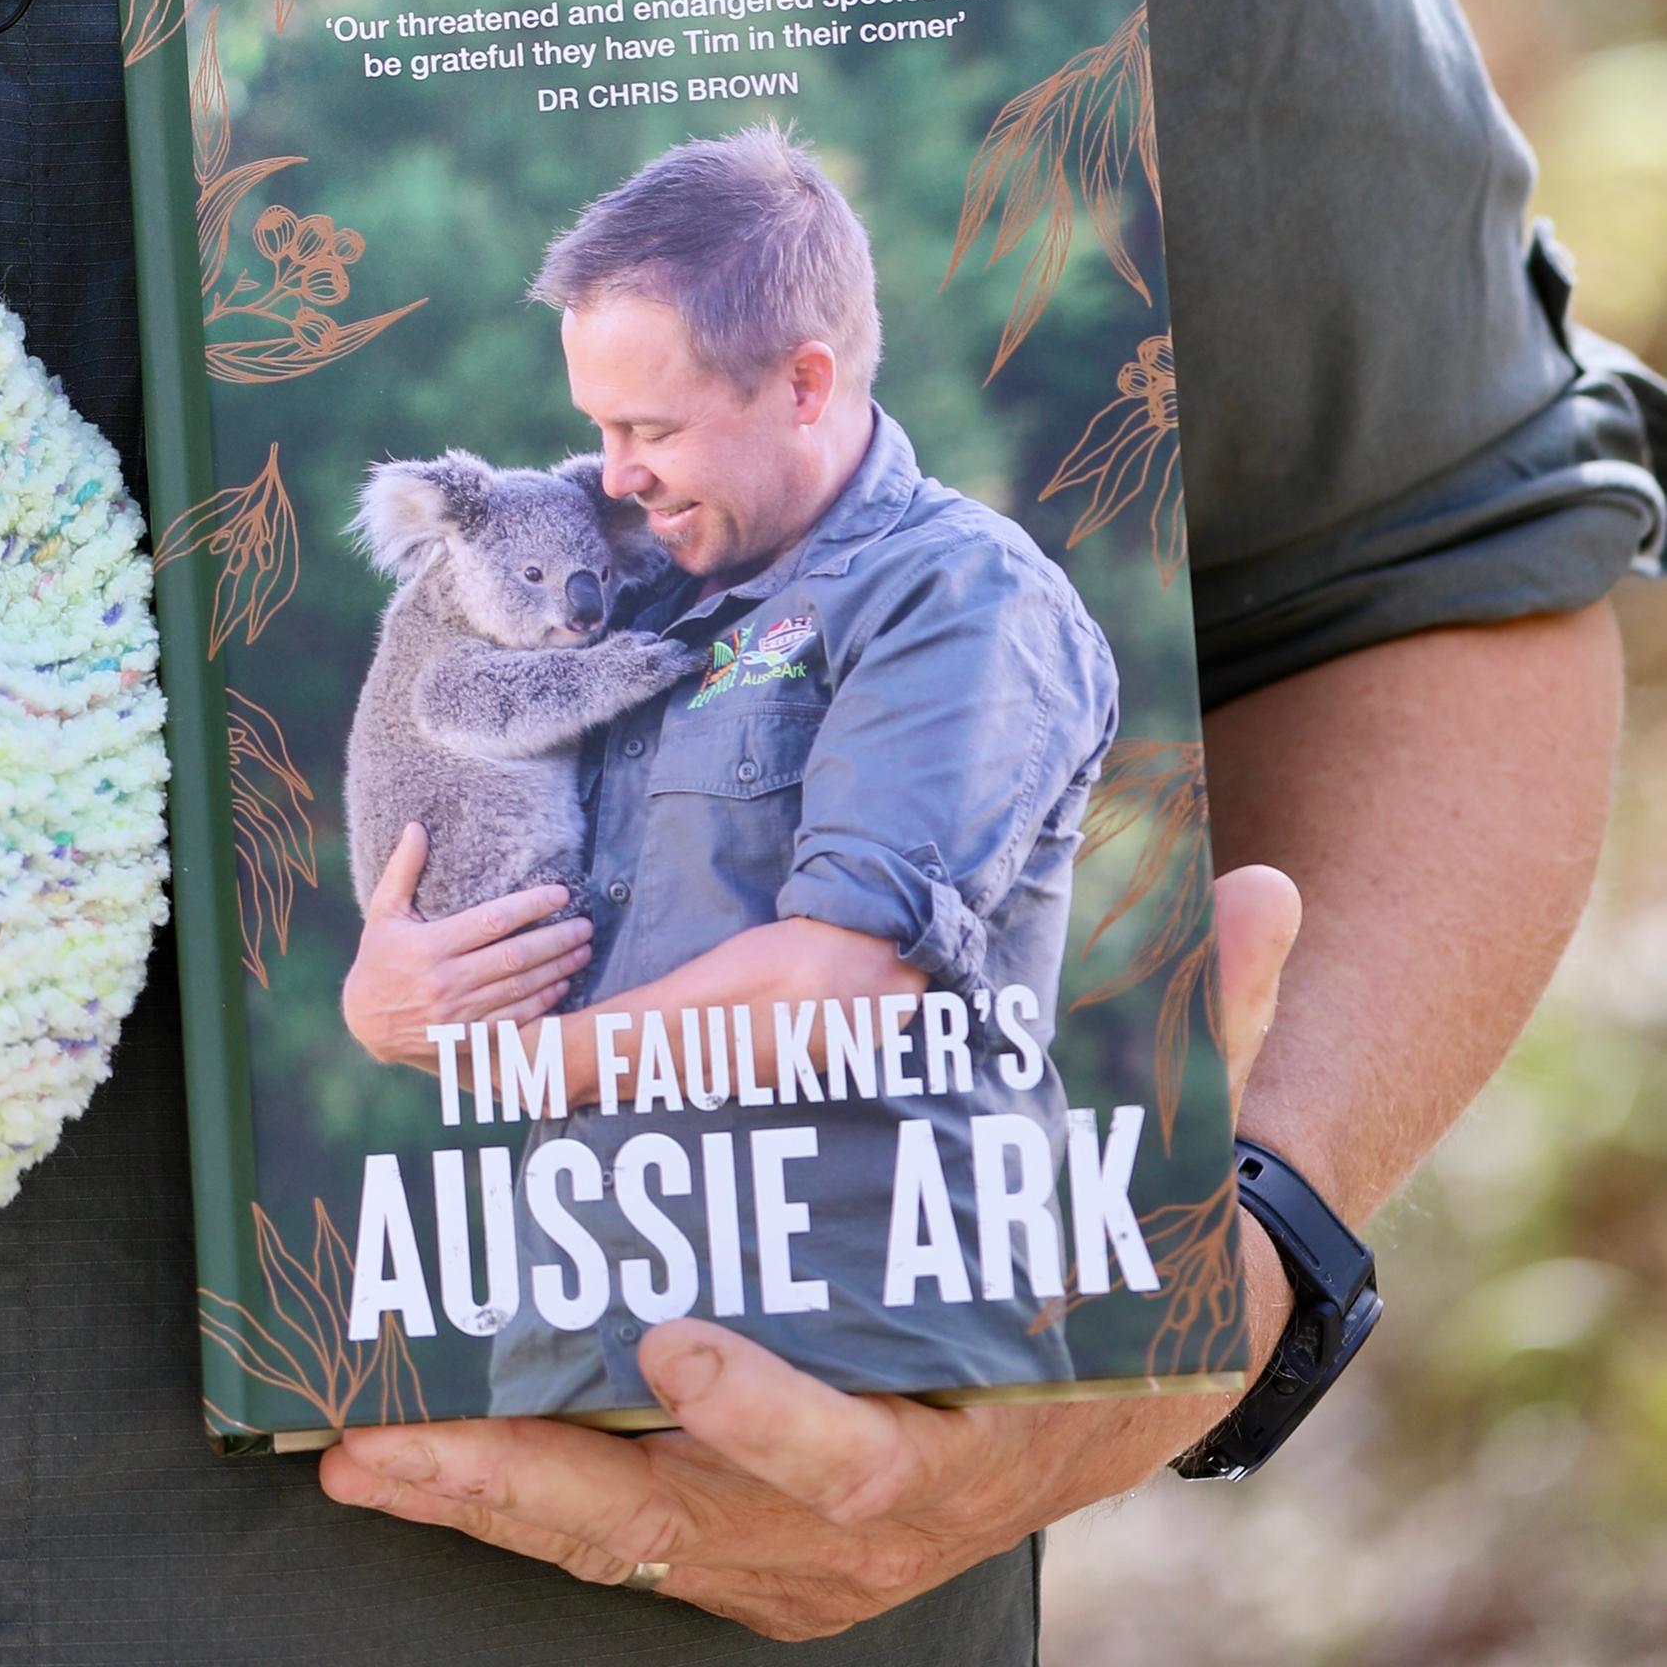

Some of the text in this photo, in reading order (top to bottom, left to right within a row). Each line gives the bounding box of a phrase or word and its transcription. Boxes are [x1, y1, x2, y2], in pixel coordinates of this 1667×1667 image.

[395, 1, 559, 37] threatened
[364, 52, 402, 78] be
[410, 42, 524, 80] grateful
[531, 40, 597, 69] they
[605, 36, 676, 61] have
[682, 28, 740, 55] Tim
[747, 25, 775, 51] in
[781, 20, 852, 48] their
[537, 71, 799, 112] DR CHRIS BROWN
[426, 983, 1041, 1126] TIM FAULKNER’S
[347, 1104, 1162, 1342] AUSSIE ARK
